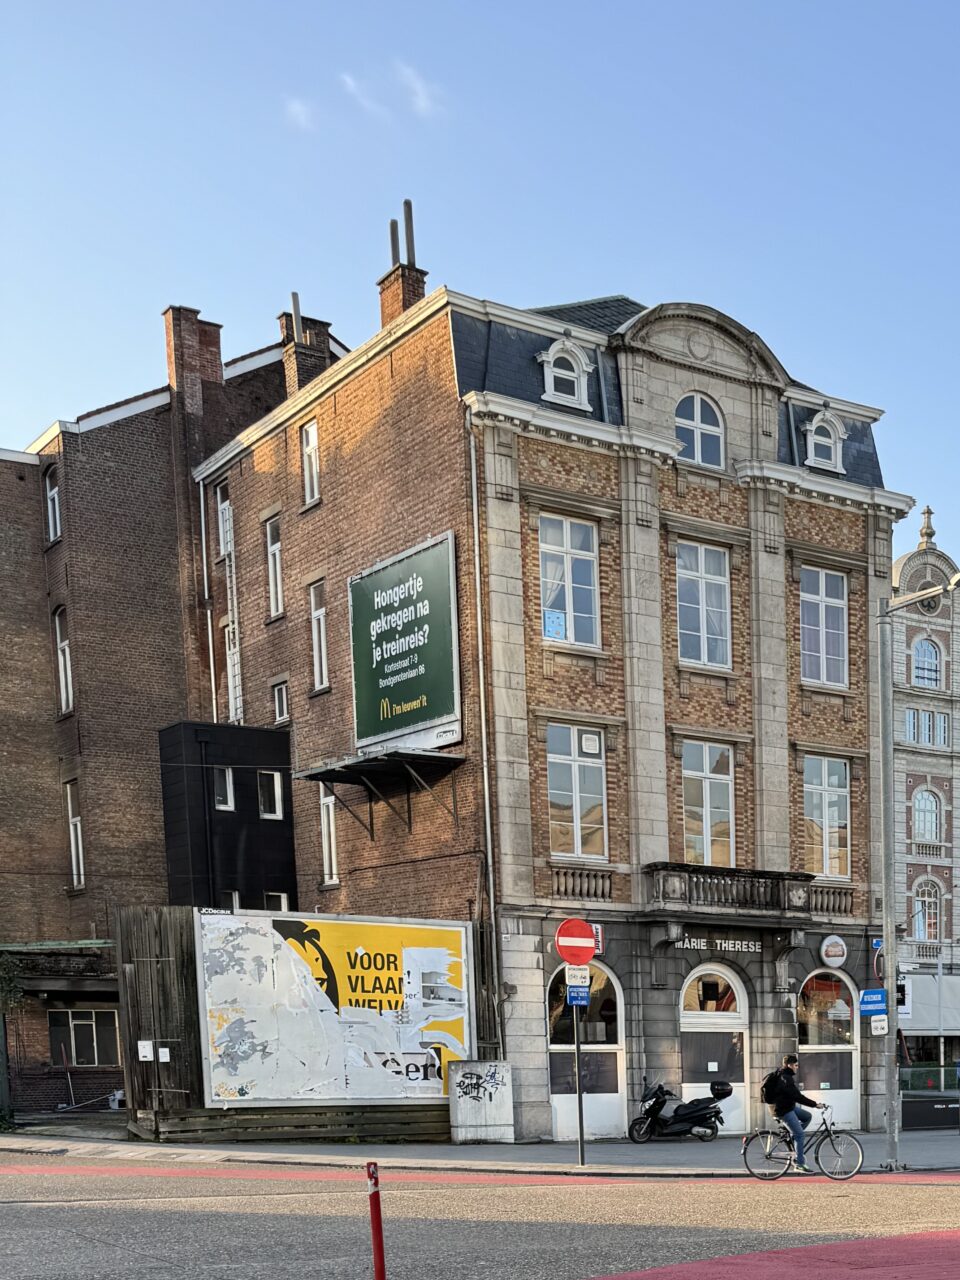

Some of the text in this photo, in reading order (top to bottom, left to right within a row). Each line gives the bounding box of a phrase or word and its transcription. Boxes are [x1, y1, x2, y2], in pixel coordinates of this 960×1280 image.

[373, 572, 423, 610] Hongertje
[370, 599, 430, 641] gekregen na
[372, 623, 430, 669] je treinreis?
[384, 656, 410, 674] Kortestraat
[378, 668, 418, 688] Bondgenotenlaan
[200, 907, 232, 915] JCDecaux
[674, 938, 763, 953] MARIE THERESE
[346, 951, 399, 972] VOOR
